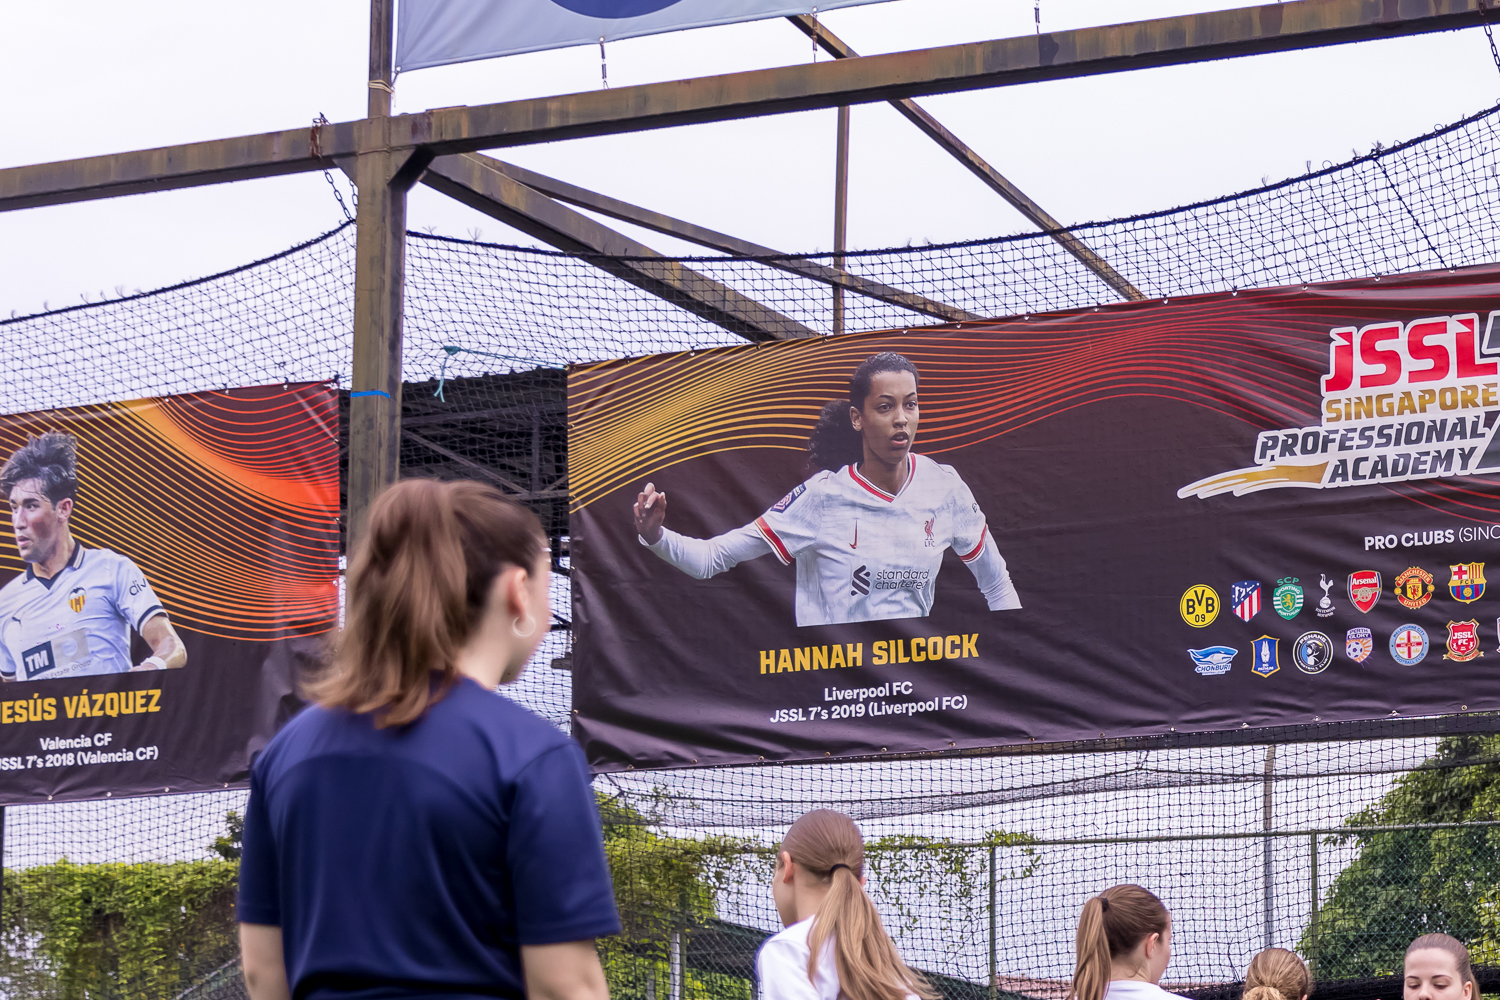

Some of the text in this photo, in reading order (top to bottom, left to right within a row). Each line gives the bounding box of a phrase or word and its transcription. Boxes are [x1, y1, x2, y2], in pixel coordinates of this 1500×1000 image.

[1325, 318, 1498, 392] JSSL
[1325, 383, 1499, 423] SINGAPORE
[1259, 415, 1489, 461] PROFESSIONAL
[1327, 446, 1478, 484] ACADEMY
[1364, 534, 1398, 551] PRO
[1400, 529, 1455, 547] CLUBS
[876, 569, 930, 580] standard
[1276, 576, 1300, 586] SCP
[1352, 576, 1377, 585] Arsenal
[1397, 568, 1433, 584] MANCHESTER
[1275, 585, 1301, 597] SPORTING
[1186, 589, 1215, 615] BVB
[1403, 597, 1428, 607] UNITED
[1194, 614, 1206, 623] 09
[1277, 608, 1301, 617] PORTUGAL
[1452, 631, 1474, 640] JSSL
[1457, 638, 1469, 646] FC
[25, 650, 50, 672] TM
[759, 633, 979, 675] HANNAH SILCOCK
[1196, 664, 1231, 673] CHONBURI
[824, 681, 914, 703] Liverpool FC
[0, 689, 162, 724] ESÚS VÁZQUEZ
[769, 709, 807, 724] JSSL
[831, 703, 866, 719] 2019
[868, 697, 939, 717] (Liverpool
[942, 694, 968, 711] FC)
[39, 733, 113, 751] Valencia CF
[45, 753, 75, 768] 2018
[77, 749, 134, 767] (Valencia
[136, 746, 159, 761] CF)
